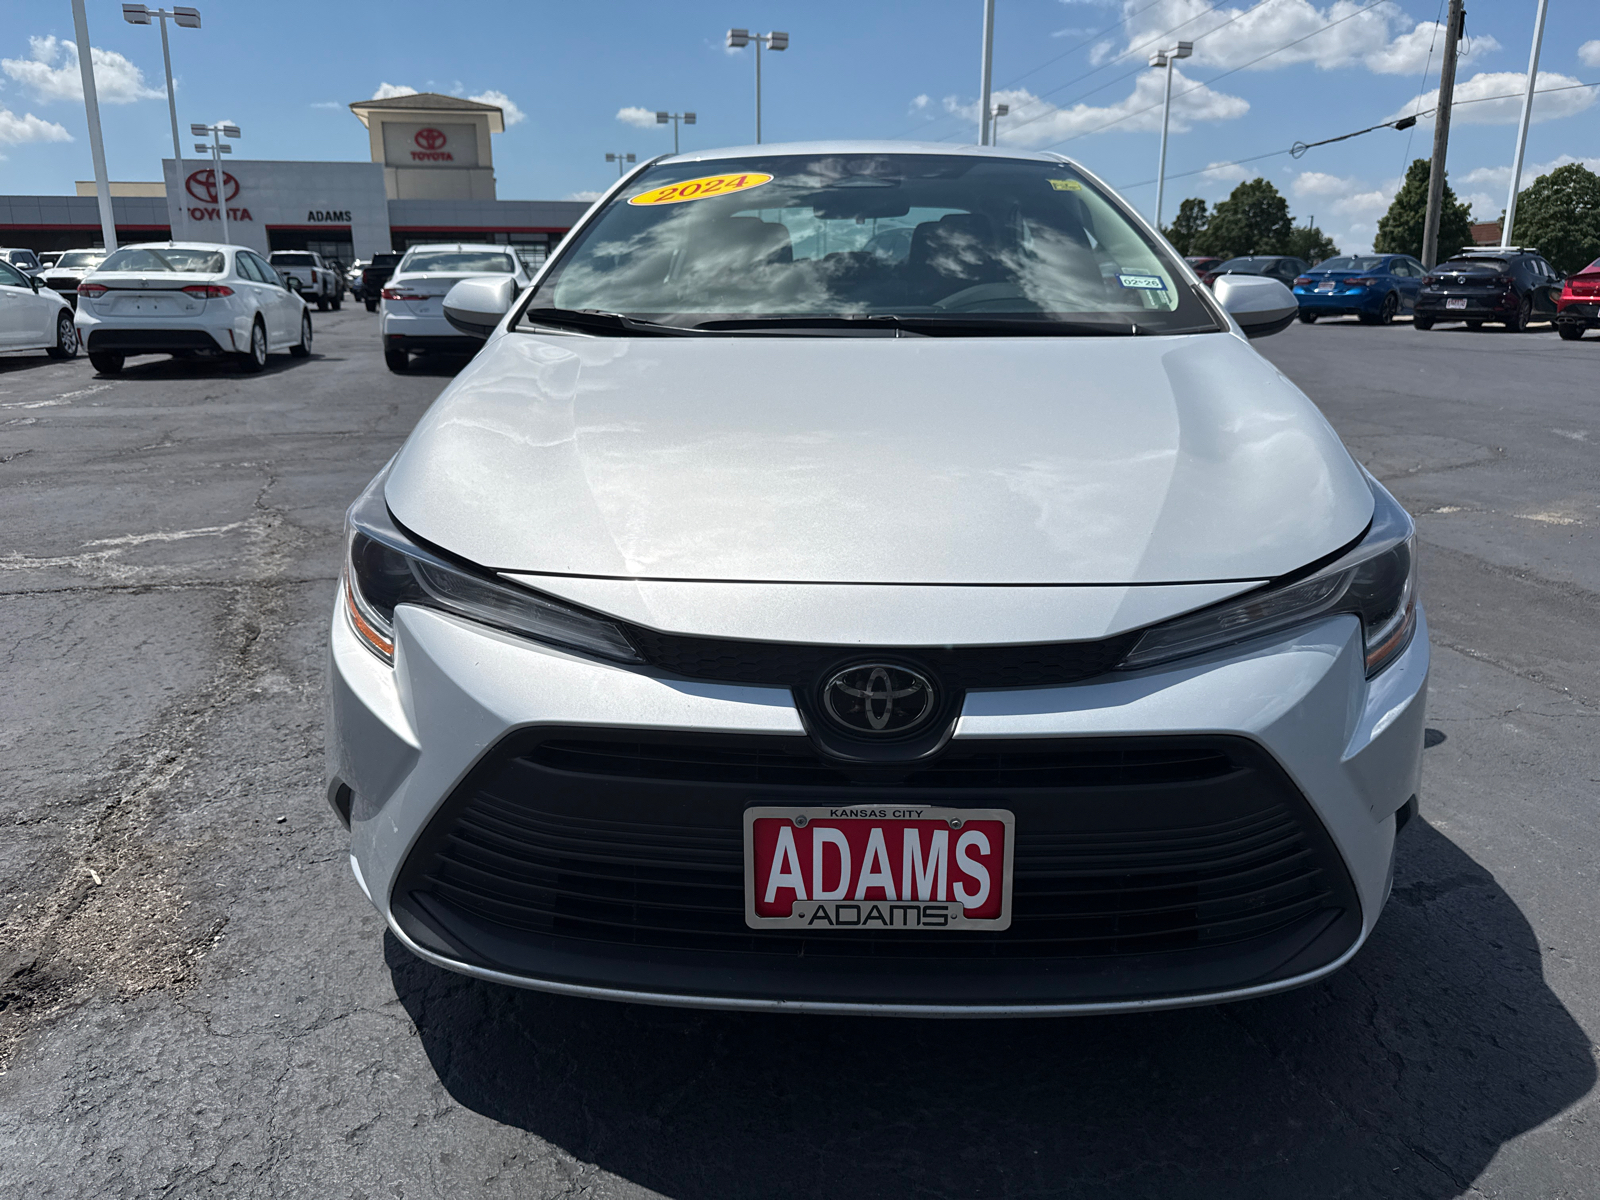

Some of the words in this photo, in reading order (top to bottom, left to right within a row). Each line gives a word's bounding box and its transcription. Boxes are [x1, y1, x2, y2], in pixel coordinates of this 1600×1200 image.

[410, 151, 454, 162] TOYOTA
[653, 175, 748, 202] 2024
[178, 207, 253, 221] OYOTA
[307, 210, 352, 222] ADAMS
[829, 809, 887, 818] KANSAS
[892, 810, 924, 818] CITY
[764, 826, 991, 909] ADAMS
[807, 904, 949, 926] ADAMS
